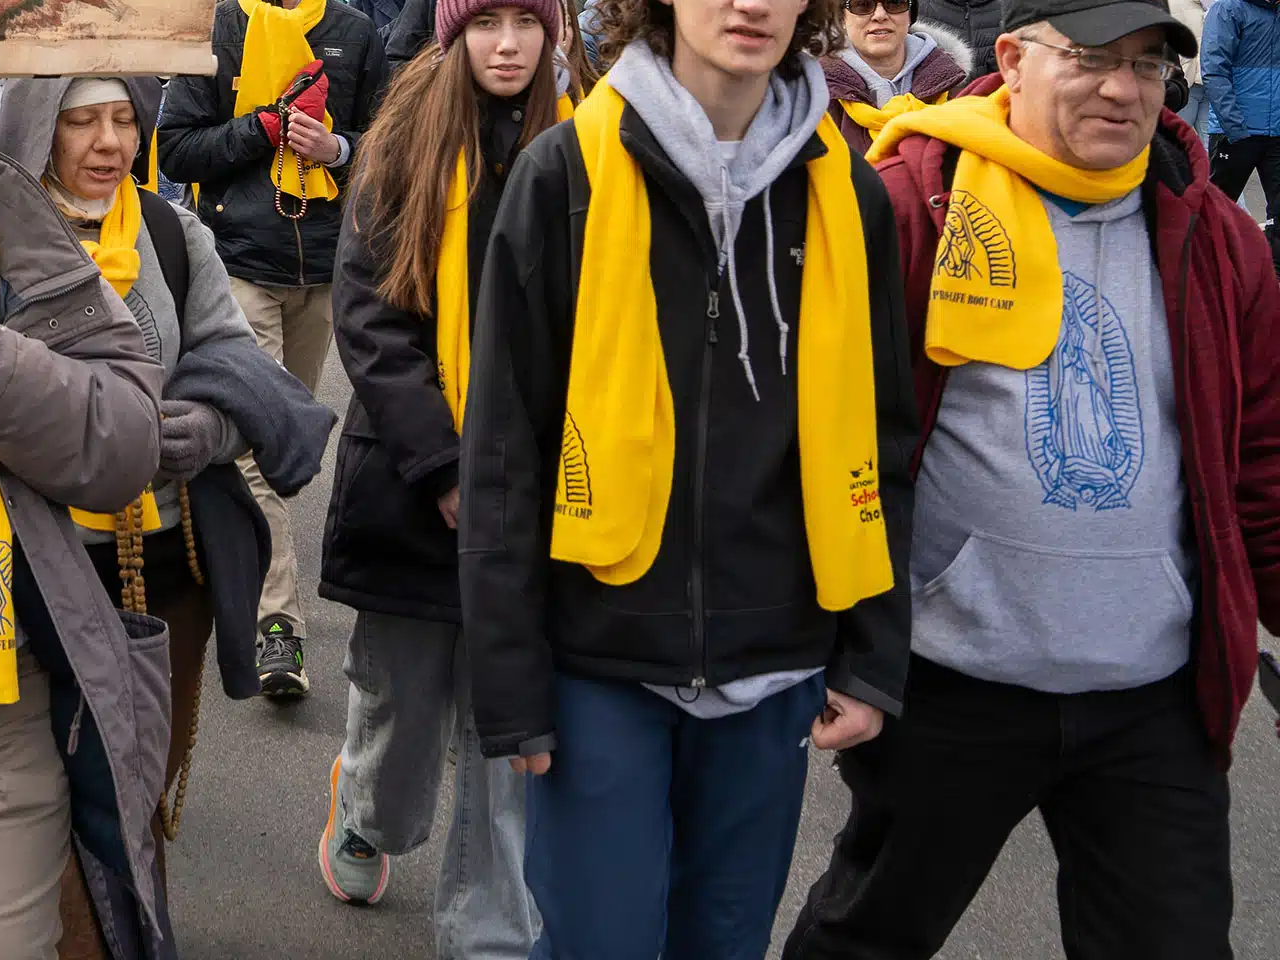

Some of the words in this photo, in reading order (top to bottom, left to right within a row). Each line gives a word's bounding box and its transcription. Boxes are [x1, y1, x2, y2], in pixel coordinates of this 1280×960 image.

[967, 294, 989, 308] BOOT
[990, 298, 1015, 311] CAMP
[851, 488, 879, 507] Scho
[568, 506, 593, 520] CAMP
[860, 507, 880, 523] Cho
